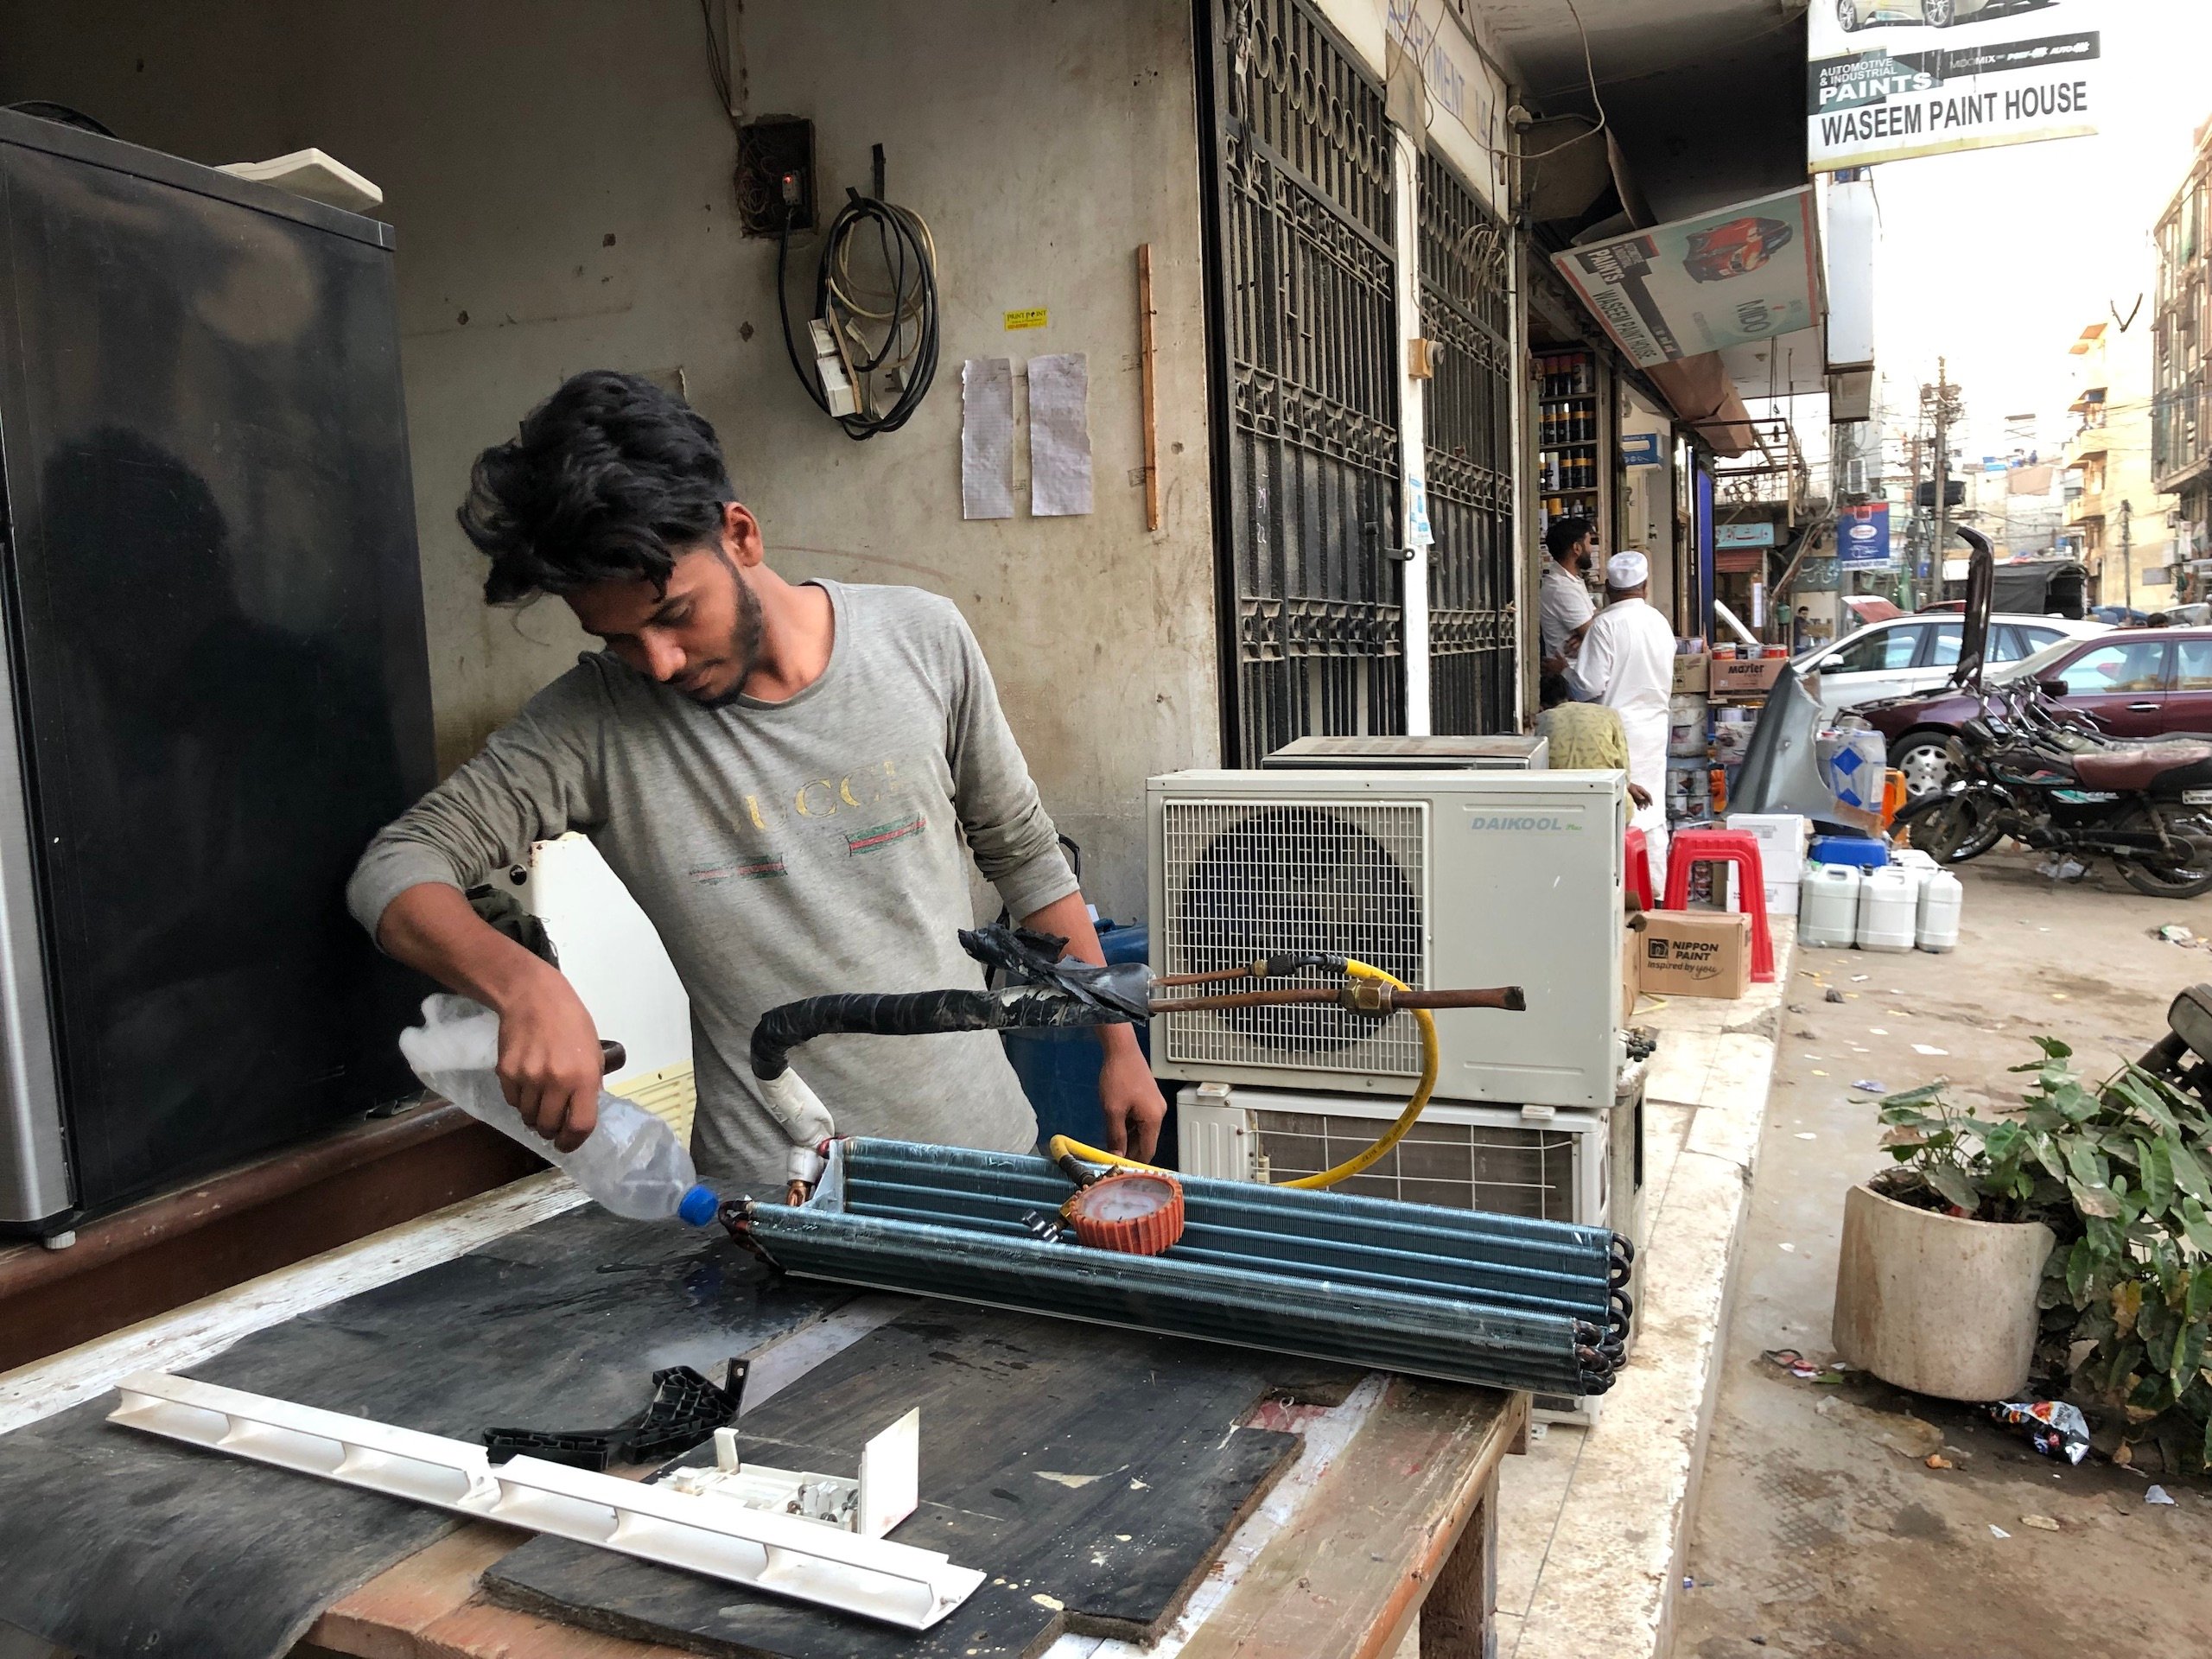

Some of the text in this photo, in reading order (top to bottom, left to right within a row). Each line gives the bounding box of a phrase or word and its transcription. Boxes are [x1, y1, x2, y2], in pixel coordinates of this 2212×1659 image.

[1820, 58, 1893, 78] AUTOMOTIVE
[1820, 67, 1897, 86] & INDUSTRIAL
[1819, 72, 1932, 105] PAINTS
[1821, 81, 2088, 146] WASEEM PAINT HOUSE
[1587, 248, 1625, 283] PAINTS
[1592, 289, 1633, 326] WASEEM
[1736, 298, 1771, 333] MIDO
[1471, 817, 1562, 830] DAIKOOL
[1672, 941, 1719, 952] NIPPON
[1675, 950, 1711, 961] PAINT
[1648, 961, 1682, 970] Inspired
[1684, 963, 1694, 972] by
